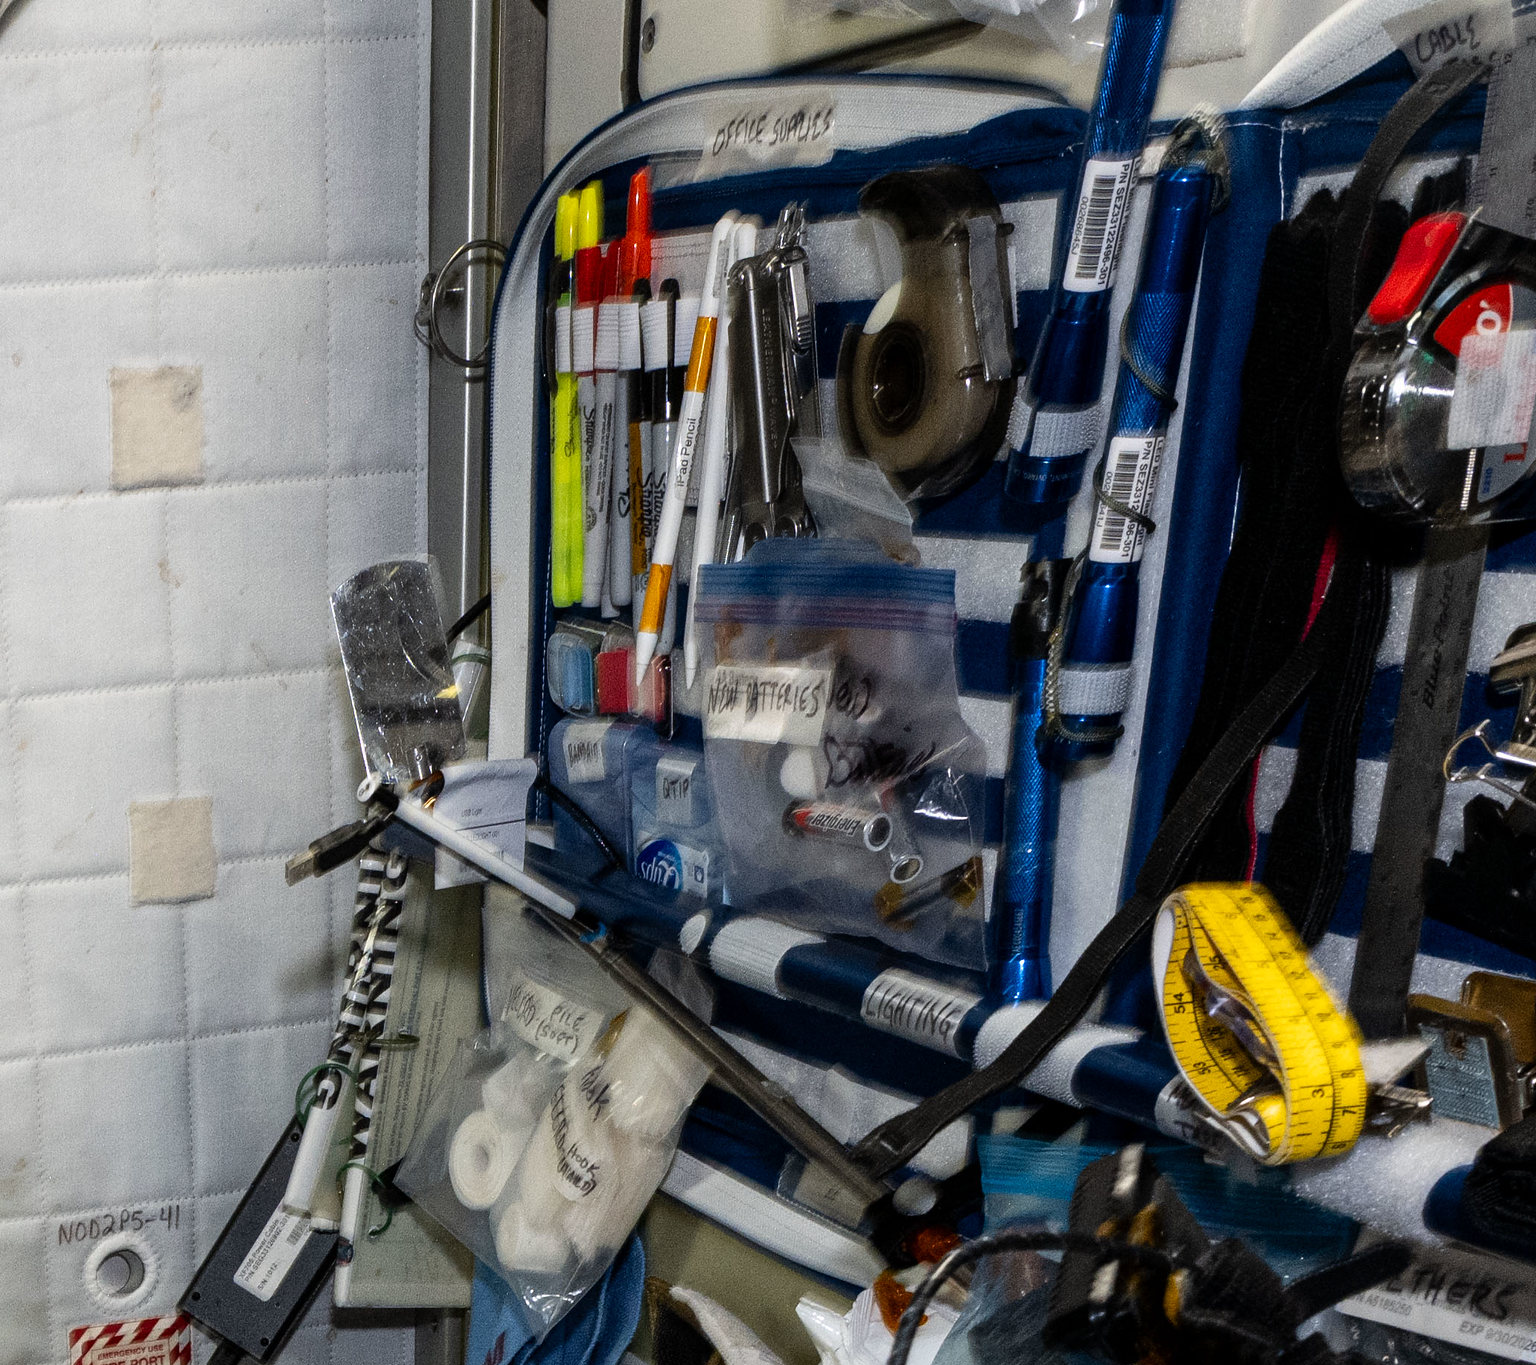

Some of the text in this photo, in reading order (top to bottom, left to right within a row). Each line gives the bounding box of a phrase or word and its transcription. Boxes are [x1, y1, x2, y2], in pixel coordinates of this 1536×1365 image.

[1416, 15, 1481, 63] CABLE
[713, 111, 768, 157] OFFICE
[1121, 163, 1132, 180] P/N
[676, 418, 698, 487] iPad Pencil
[707, 677, 737, 716] NEW
[745, 680, 826, 719] BATTERIES
[662, 775, 690, 801] QTIP
[809, 809, 860, 838] Energizer
[865, 975, 958, 1040] LIGHTING
[58, 1204, 181, 1246] NOD2P5-41
[97, 1343, 164, 1361] EMERGENCY USE
